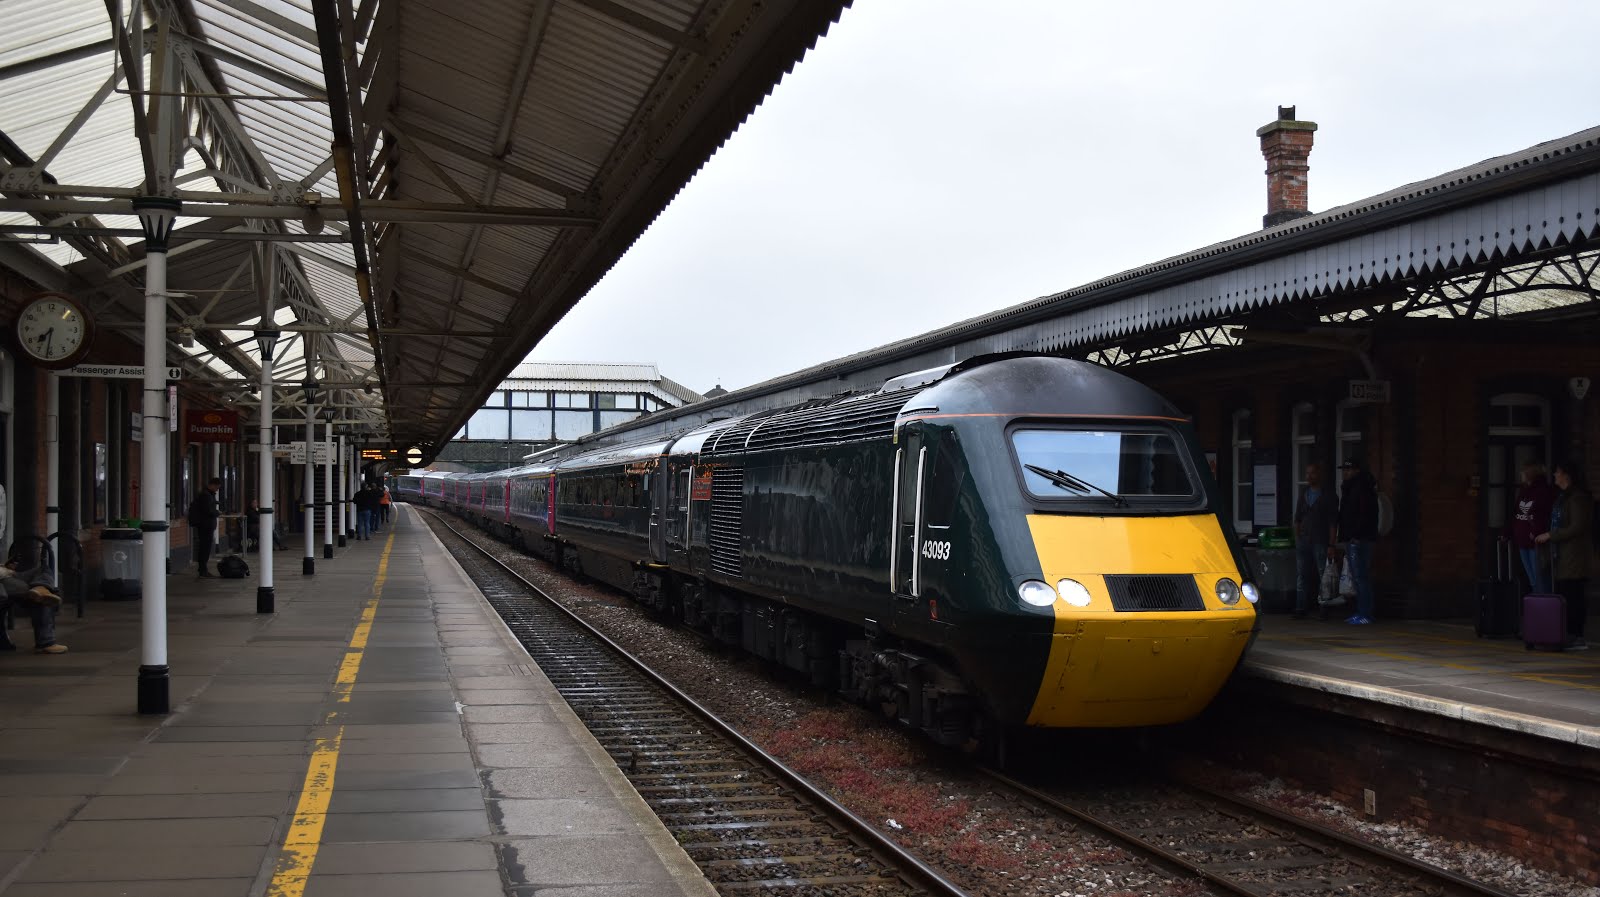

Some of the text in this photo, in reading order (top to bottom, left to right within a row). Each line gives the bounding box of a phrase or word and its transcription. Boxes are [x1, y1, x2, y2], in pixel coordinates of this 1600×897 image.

[72, 366, 117, 375] Passenger
[191, 425, 233, 434] Pumpkin
[922, 540, 951, 560] 43093
